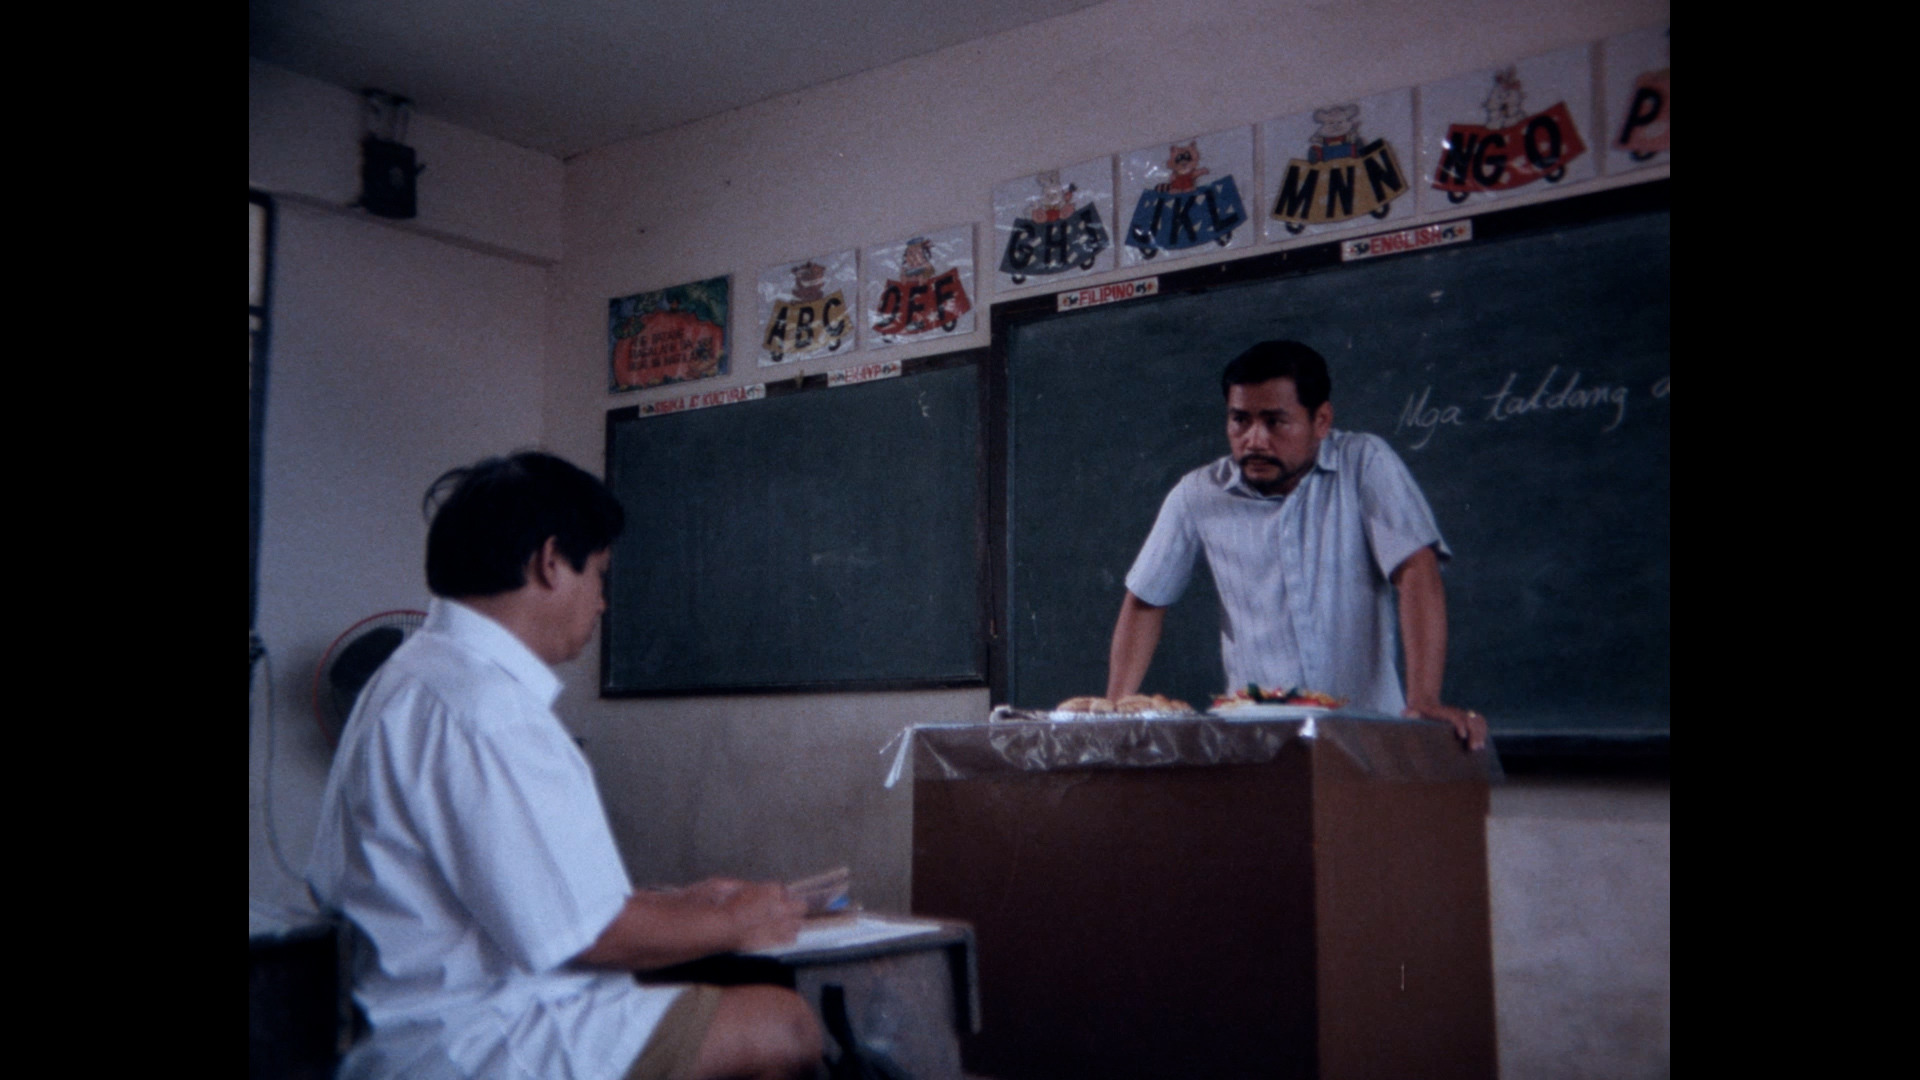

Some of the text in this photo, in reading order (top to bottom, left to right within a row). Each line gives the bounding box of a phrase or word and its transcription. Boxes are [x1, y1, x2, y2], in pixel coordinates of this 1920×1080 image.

[1618, 87, 1662, 145] P
[1369, 225, 1442, 255] ENGLISH
[1078, 283, 1135, 305] FILIPINO
[767, 297, 845, 349] ABC
[1394, 384, 1464, 450] Mga
